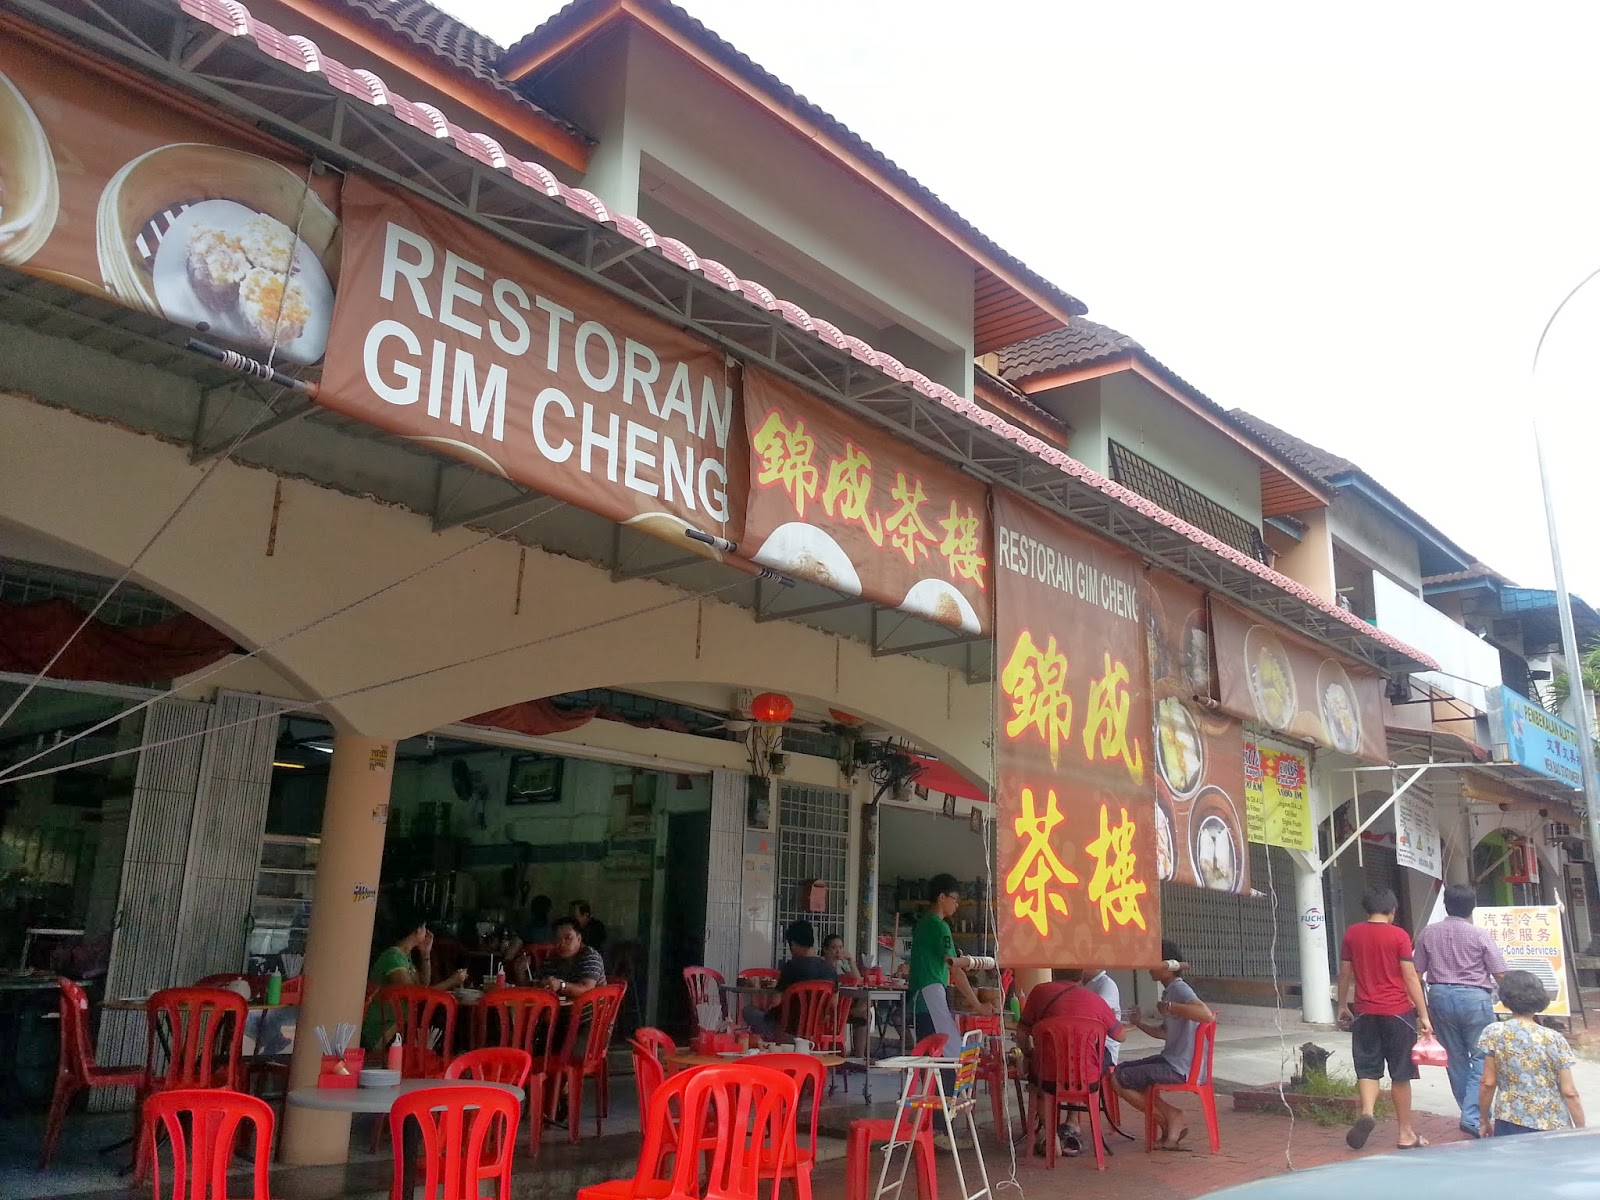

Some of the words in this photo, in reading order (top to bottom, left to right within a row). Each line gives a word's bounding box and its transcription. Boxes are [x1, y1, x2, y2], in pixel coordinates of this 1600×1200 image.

[379, 221, 733, 449] RESTORAN
[363, 319, 508, 441] GIM
[532, 387, 730, 523] CHENG
[753, 408, 988, 590] 錦成茶樓
[999, 526, 1073, 595] RESTORAN
[1077, 562, 1098, 606] GIM
[1002, 629, 1144, 787] 錦成
[1006, 787, 1147, 937] 茶樓
[1483, 912, 1551, 927] 汽车冷气
[1498, 944, 1525, 956] ir-Cond
[1526, 944, 1558, 956] Services
